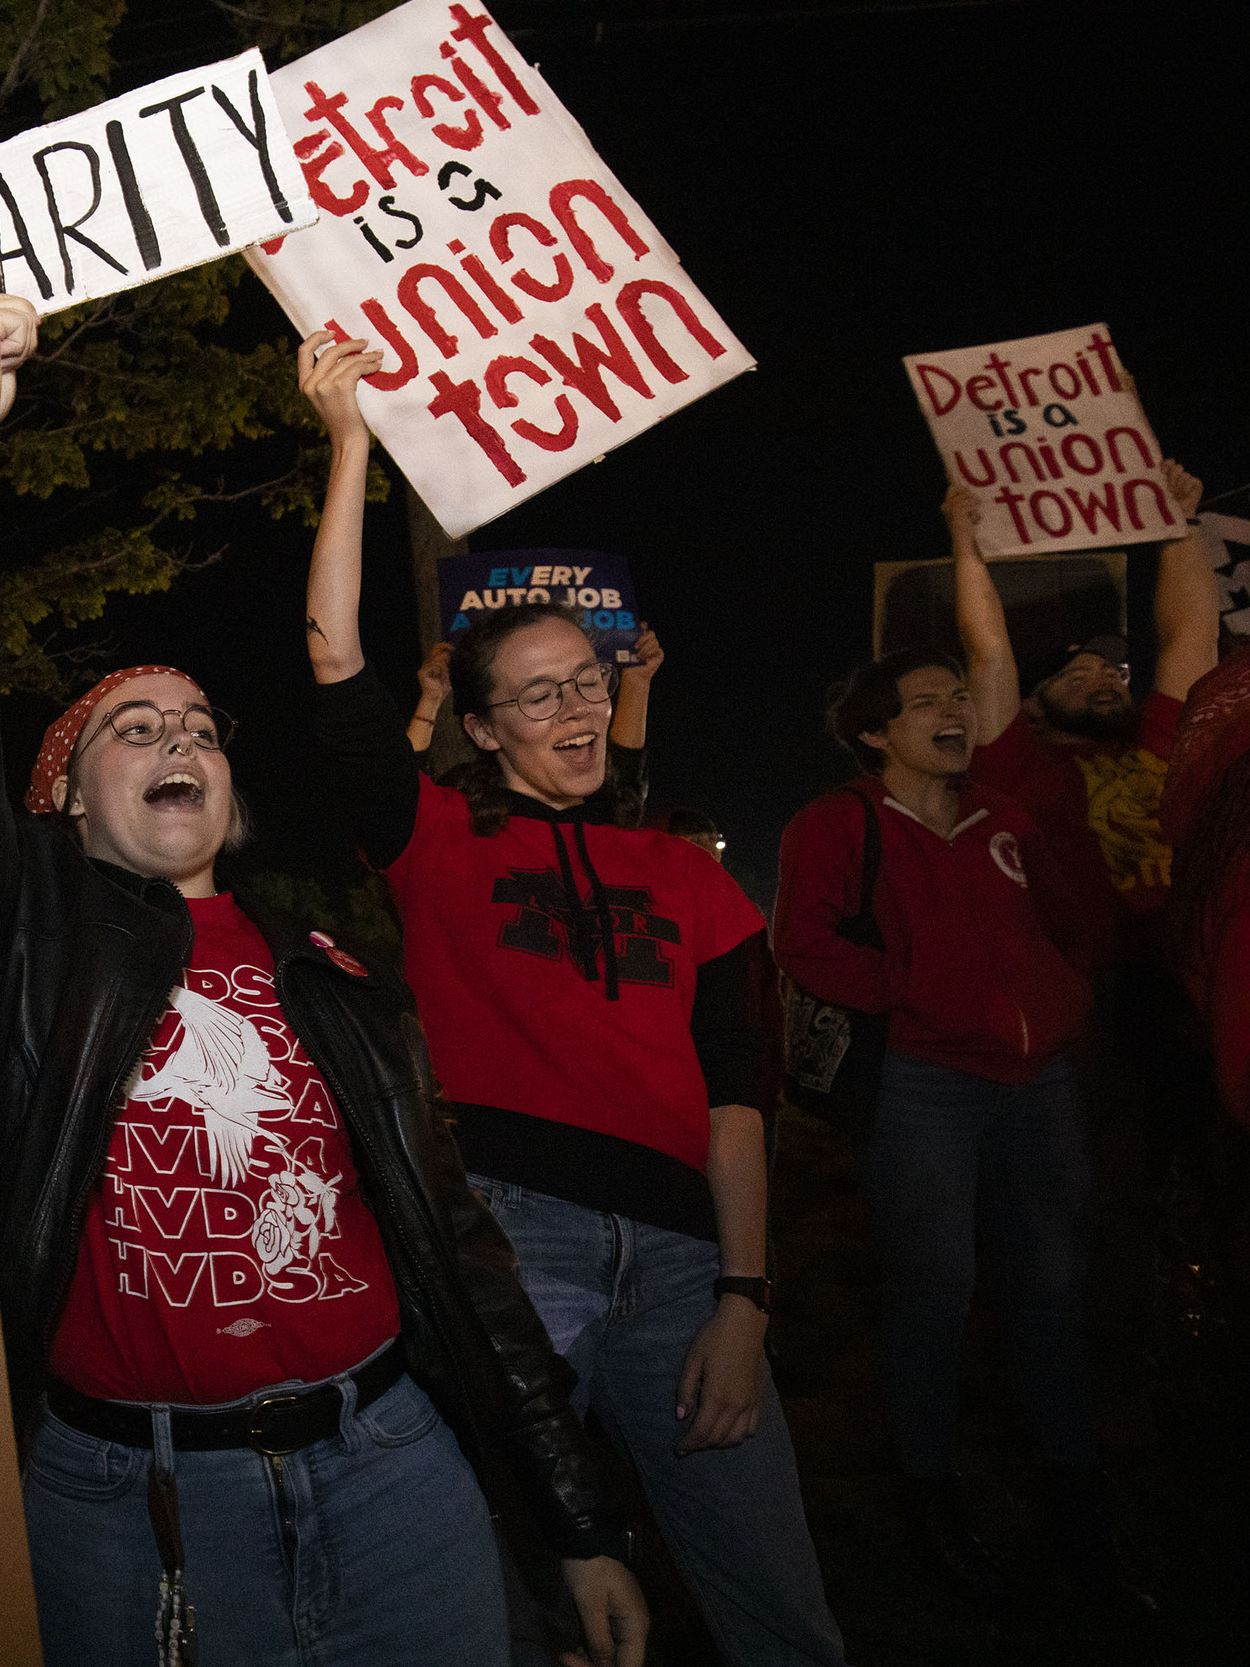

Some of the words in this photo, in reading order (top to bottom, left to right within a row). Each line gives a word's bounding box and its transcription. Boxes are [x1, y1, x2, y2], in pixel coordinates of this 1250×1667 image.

[260, 0, 540, 256] etroit
[352, 194, 425, 264] is
[437, 159, 503, 212] a
[327, 176, 651, 393] union
[426, 279, 728, 488] town
[916, 333, 1122, 417] Detroit
[988, 409, 1028, 438] is
[1042, 403, 1079, 428] a
[953, 426, 1155, 488] union
[995, 478, 1177, 545] town
[459, 587, 551, 611] AUTO
[560, 587, 623, 609] JOB
[487, 565, 593, 588] EVERY
[580, 609, 636, 630] JOB
[108, 1237, 370, 1308] HVDSA
